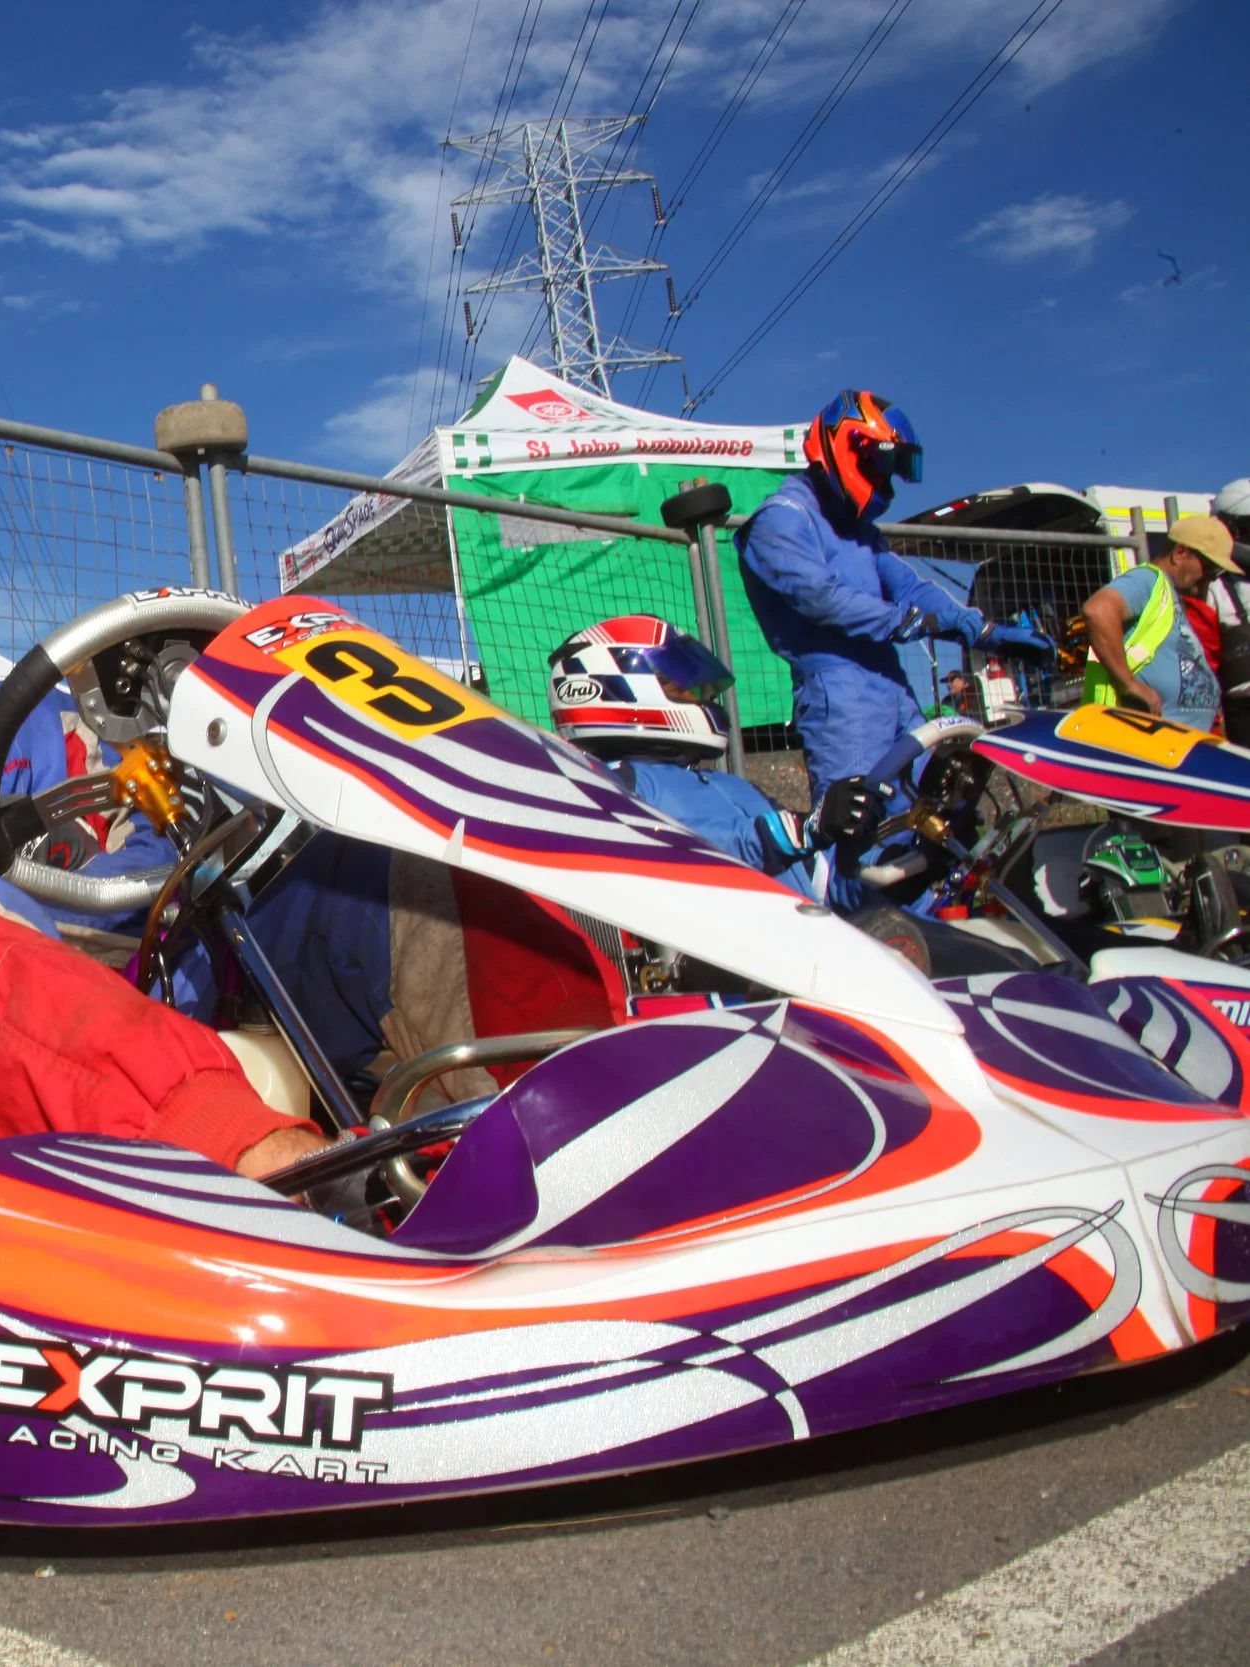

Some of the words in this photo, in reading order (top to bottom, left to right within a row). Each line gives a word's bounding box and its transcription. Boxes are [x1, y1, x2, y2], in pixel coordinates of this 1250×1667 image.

[526, 440, 550, 459] St
[567, 439, 621, 457] John
[635, 437, 754, 457] Ambulance
[305, 640, 466, 727] 3
[559, 682, 594, 700] Arai
[1101, 708, 1191, 736] 4
[213, 1447, 390, 1484] KART
